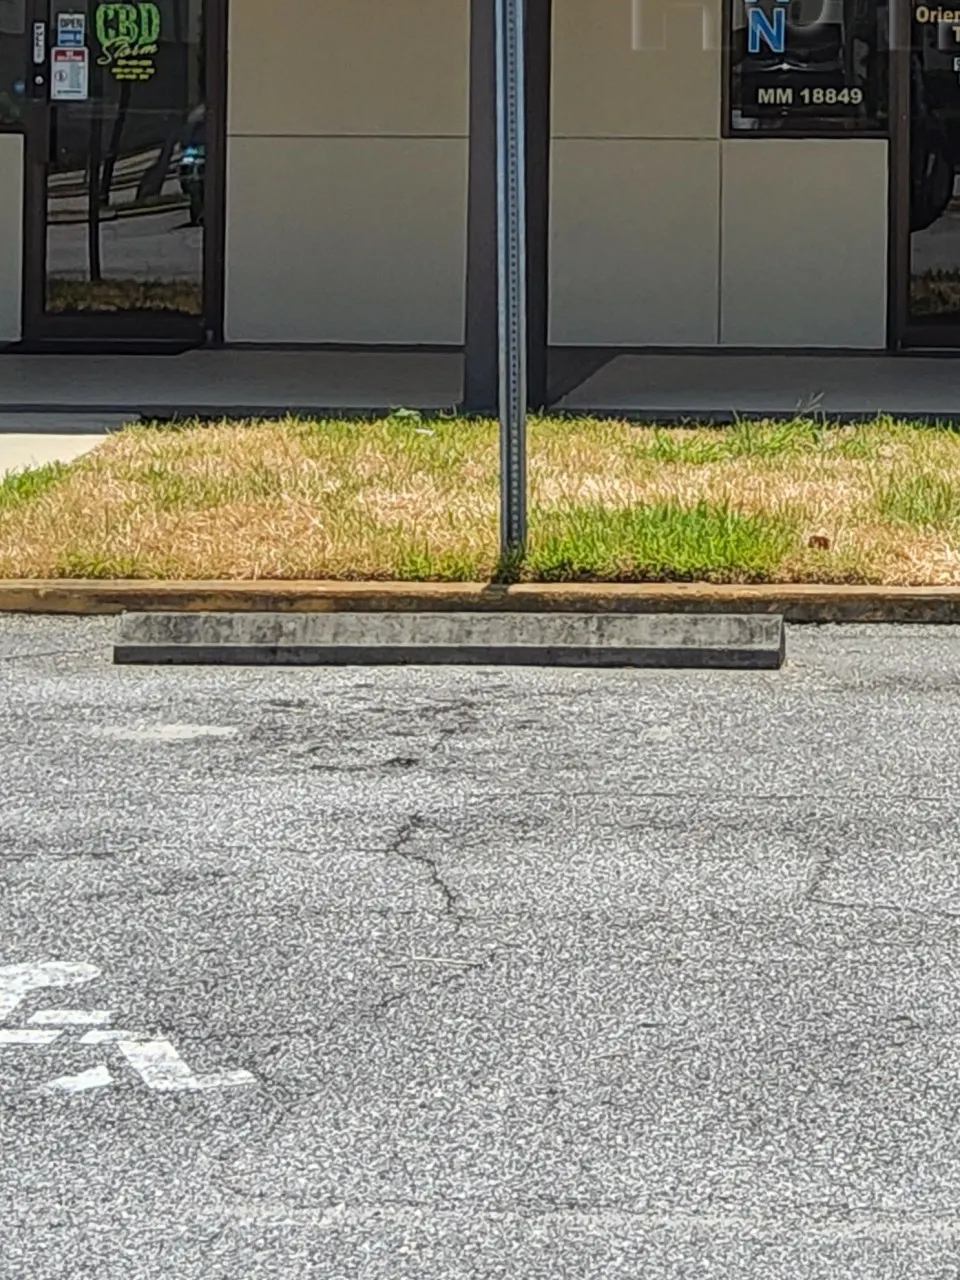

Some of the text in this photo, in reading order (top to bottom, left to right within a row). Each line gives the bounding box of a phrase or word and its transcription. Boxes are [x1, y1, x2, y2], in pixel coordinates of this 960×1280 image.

[95, 2, 160, 46] CBD
[758, 87, 863, 104] MM 18849
